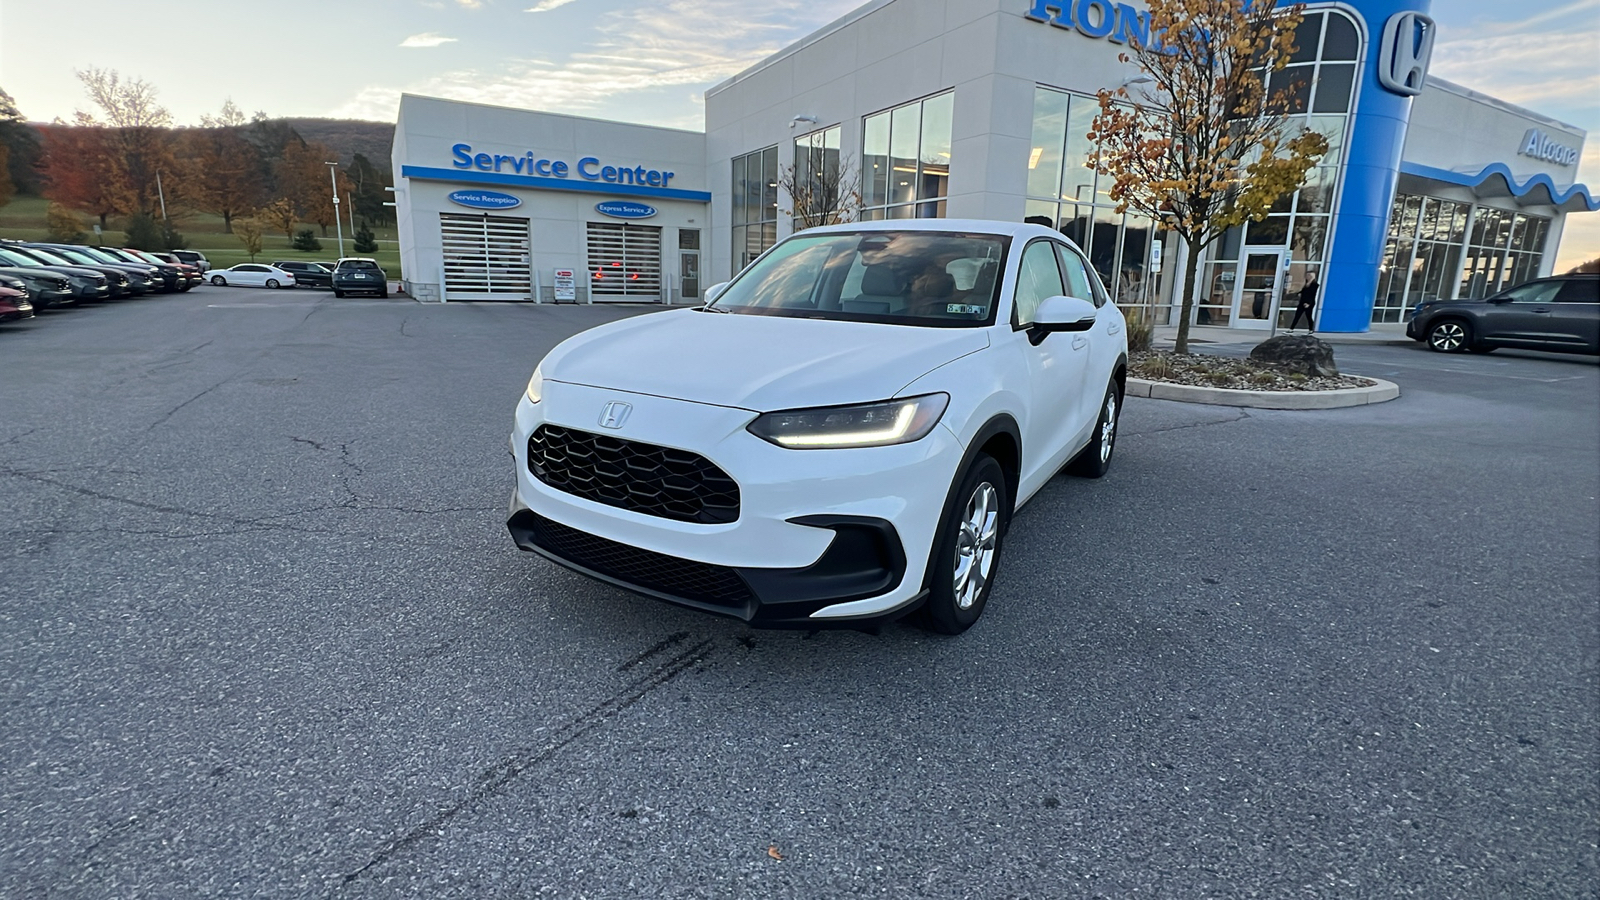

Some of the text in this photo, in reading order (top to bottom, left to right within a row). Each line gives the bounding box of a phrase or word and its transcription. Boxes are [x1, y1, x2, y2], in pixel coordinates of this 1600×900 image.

[1520, 127, 1577, 164] Altoona
[452, 143, 675, 188] Service Center
[453, 193, 517, 204] Service Reception
[599, 204, 622, 212] Express
